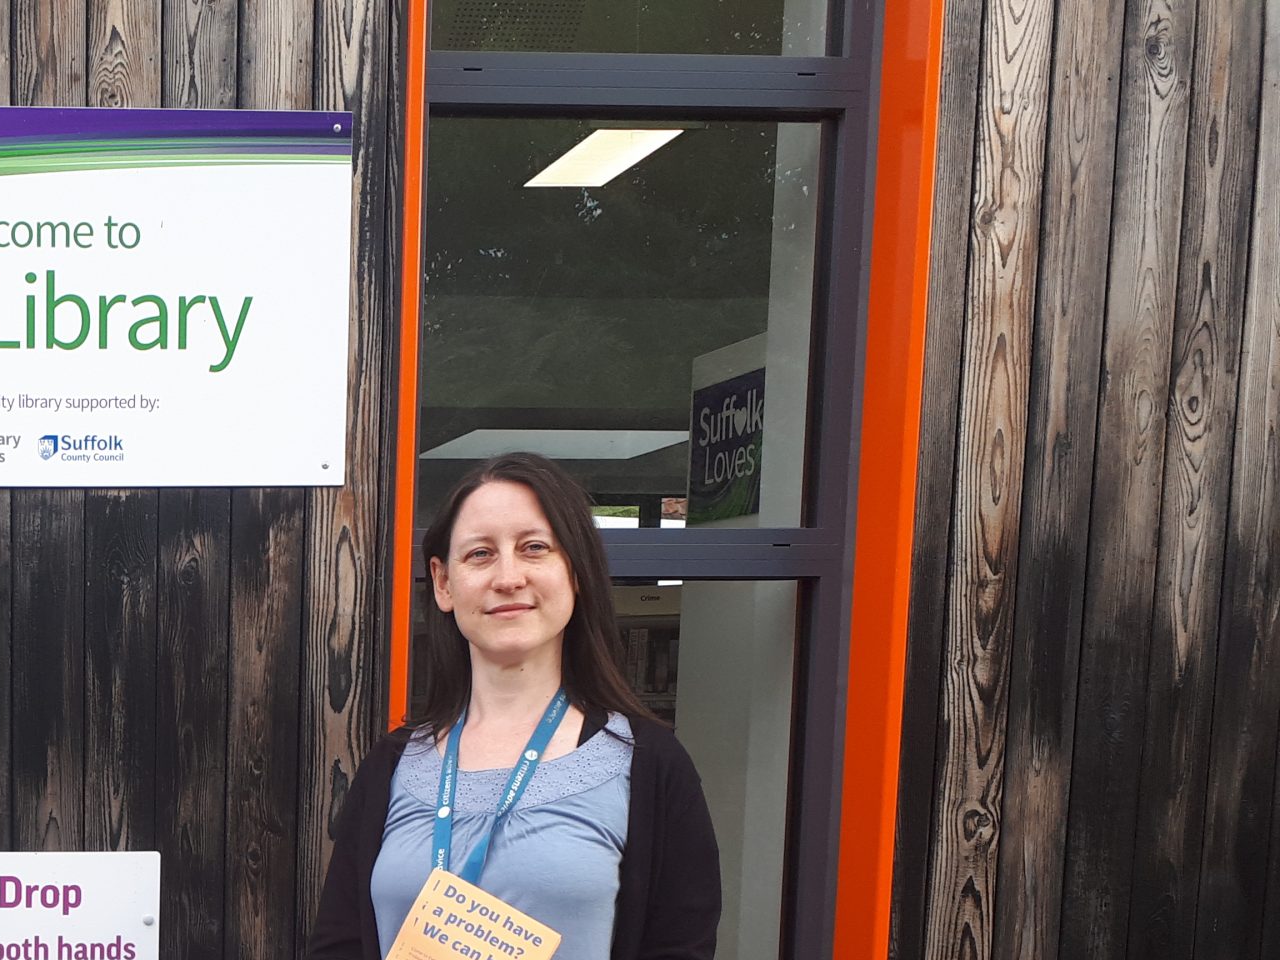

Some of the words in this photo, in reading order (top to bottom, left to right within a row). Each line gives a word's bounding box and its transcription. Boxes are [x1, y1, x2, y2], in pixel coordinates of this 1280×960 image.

[104, 215, 141, 249] to
[18, 394, 62, 412] library
[65, 395, 136, 412] supported
[140, 395, 160, 412] by:
[61, 435, 123, 451] Suffolk
[61, 453, 90, 463] County
[93, 453, 124, 462] Council
[704, 443, 755, 485] Loves
[442, 775, 453, 805] citizens
[511, 760, 530, 792] citizens
[496, 790, 516, 817] advice
[443, 884, 467, 905] Do
[469, 899, 501, 923] you
[503, 916, 543, 948] have
[422, 922, 450, 945] We
[432, 905, 444, 918] a
[443, 910, 525, 960] problem?
[57, 935, 136, 960] hands
